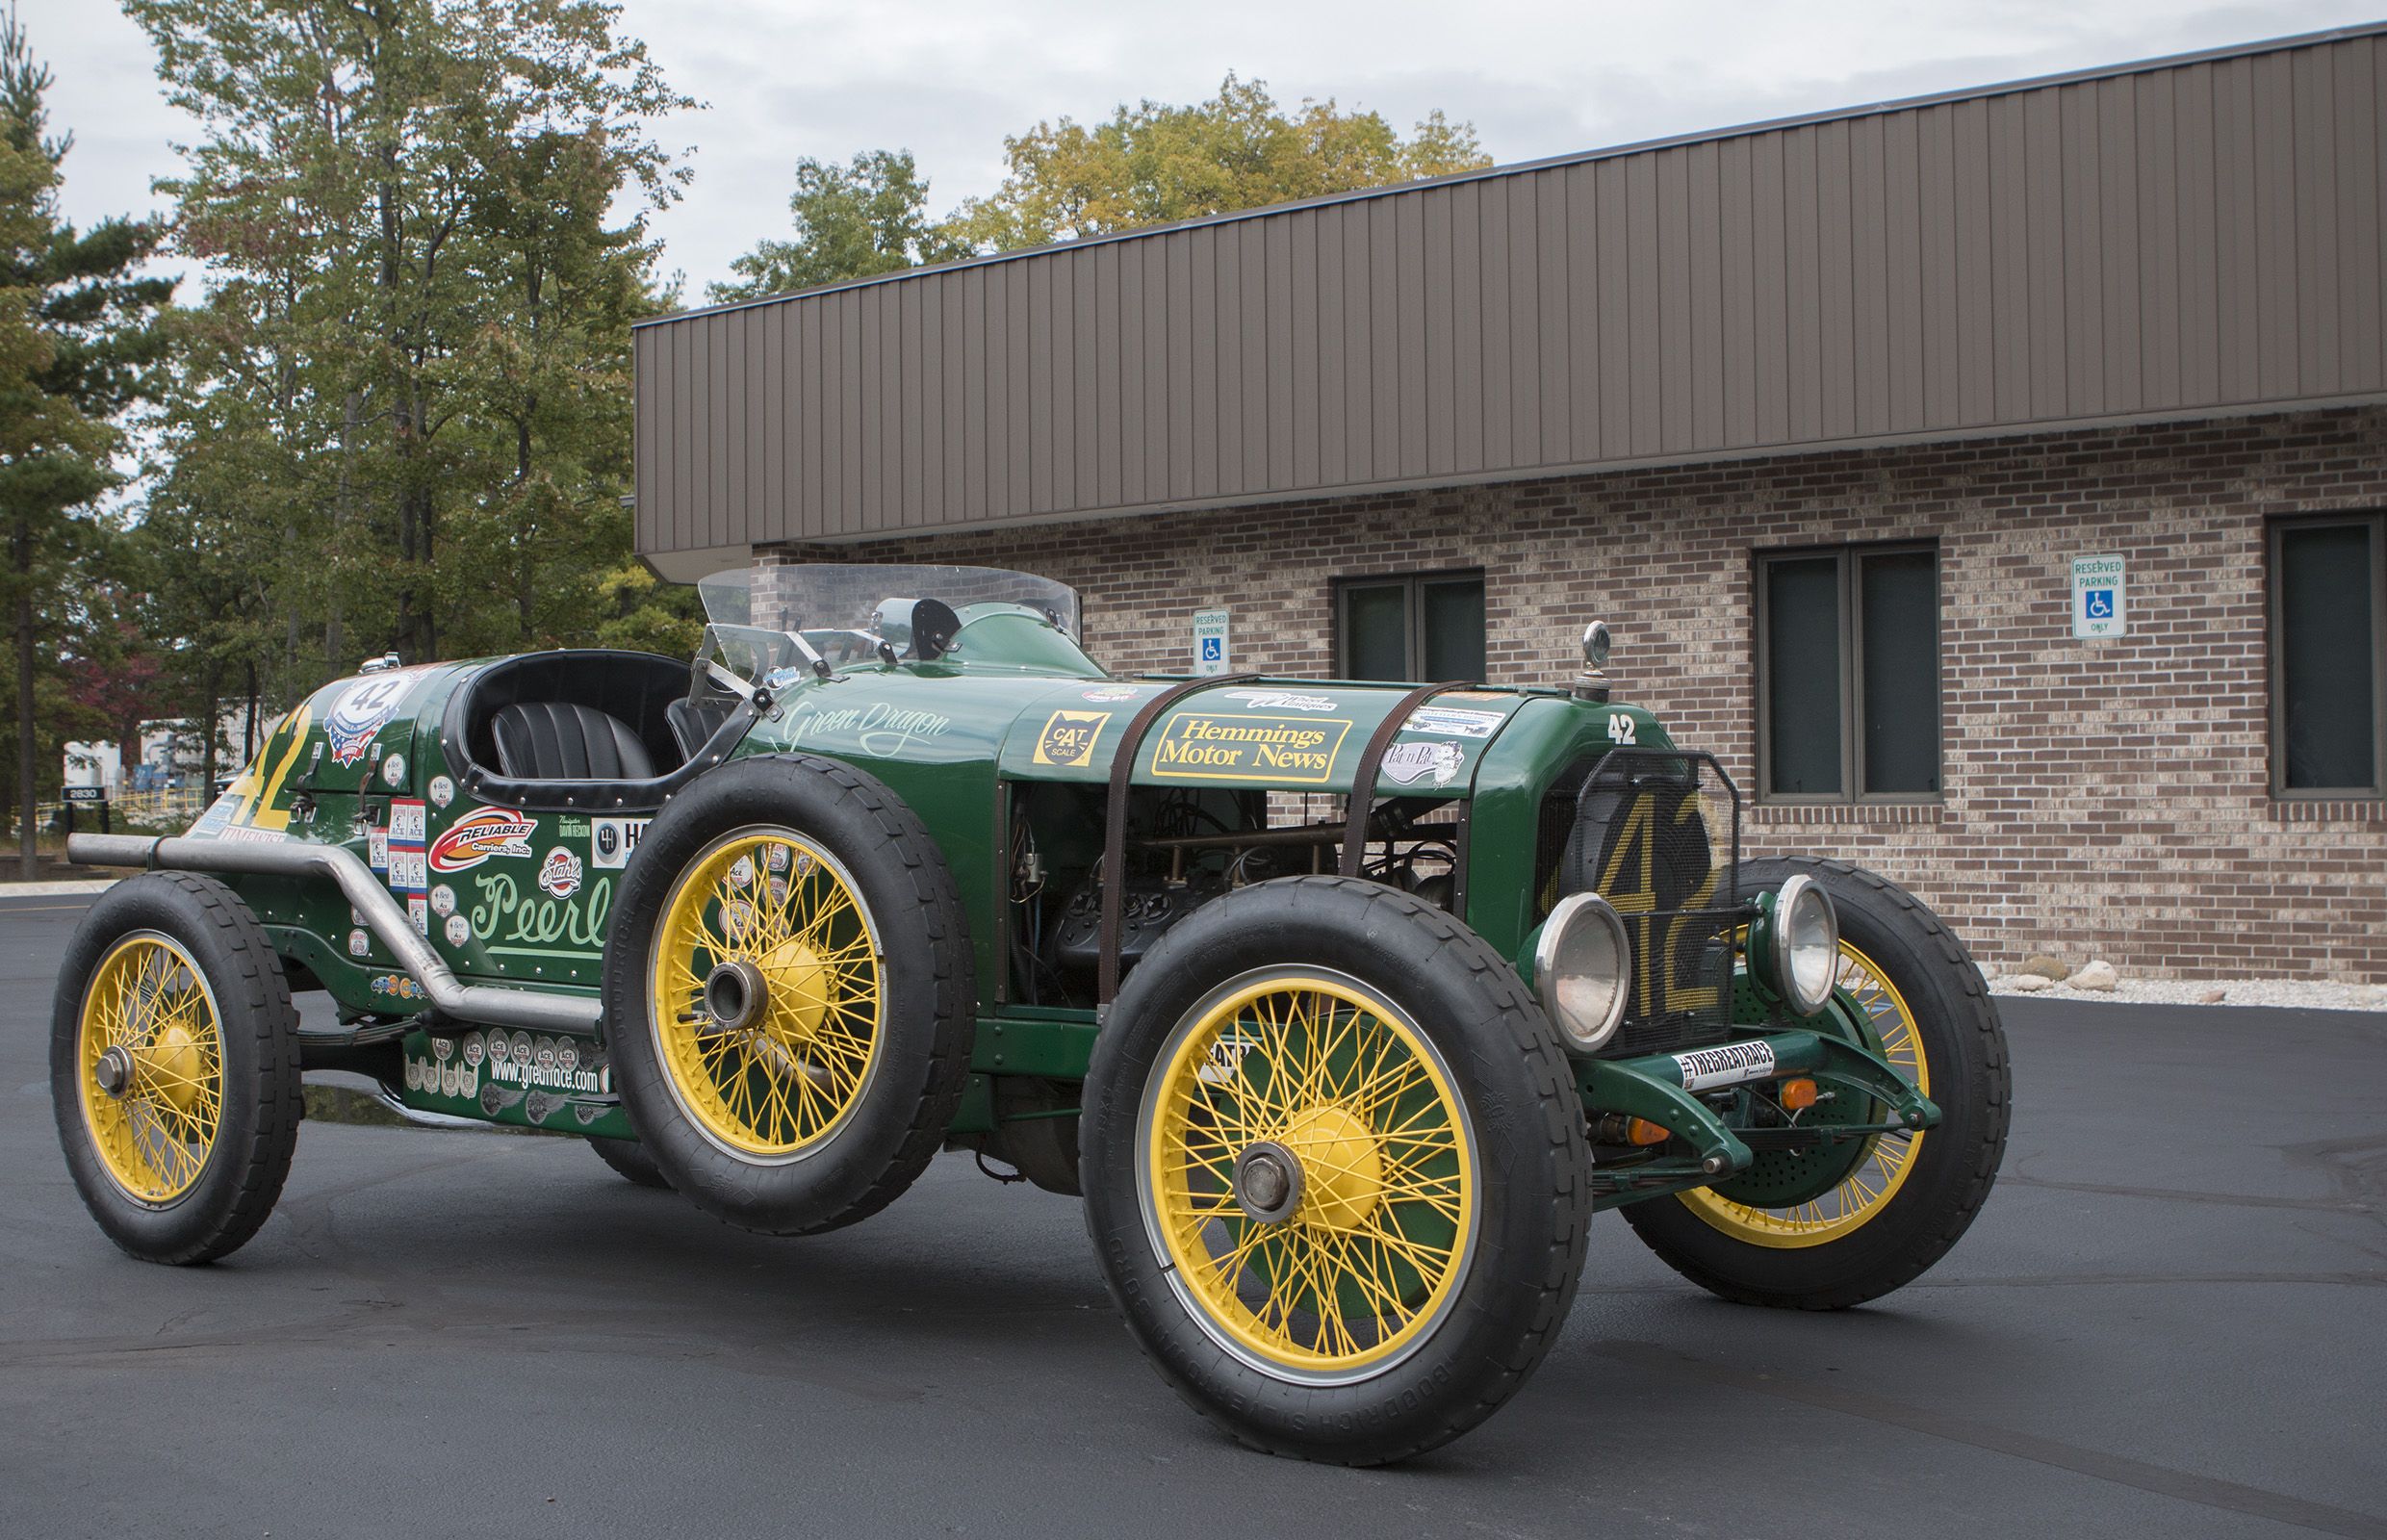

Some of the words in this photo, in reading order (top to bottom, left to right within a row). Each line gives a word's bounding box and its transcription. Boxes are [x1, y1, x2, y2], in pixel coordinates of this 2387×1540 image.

[2075, 561, 2122, 575] RESERVED
[2079, 576, 2118, 587] PARKING
[1195, 615, 1227, 625] RESERVED
[1198, 627, 1224, 635] PARKING
[2091, 623, 2108, 631] ONLY
[350, 680, 401, 711] 42
[770, 701, 860, 753] Green
[857, 702, 951, 757] Dragon
[1180, 720, 1325, 749] Hemmings
[1606, 714, 1636, 745] 42
[1053, 728, 1089, 747] CAT
[1051, 747, 1077, 757] SCALE
[1160, 739, 1243, 766] Motor
[1251, 743, 1328, 770] News
[1388, 745, 1404, 764] Pat
[1416, 746, 1432, 765] Pat
[69, 789, 96, 798] 2830
[459, 824, 530, 843] RELIABLE
[471, 842, 511, 855] Carriers,
[511, 844, 531, 855] Inc.
[392, 874, 405, 883] ACE
[410, 875, 424, 884] ACE
[1595, 791, 1725, 1017] 42
[492, 1042, 504, 1051] ACE
[561, 1051, 573, 1060] ACE
[1680, 1042, 1774, 1079] #THEGREATRACE
